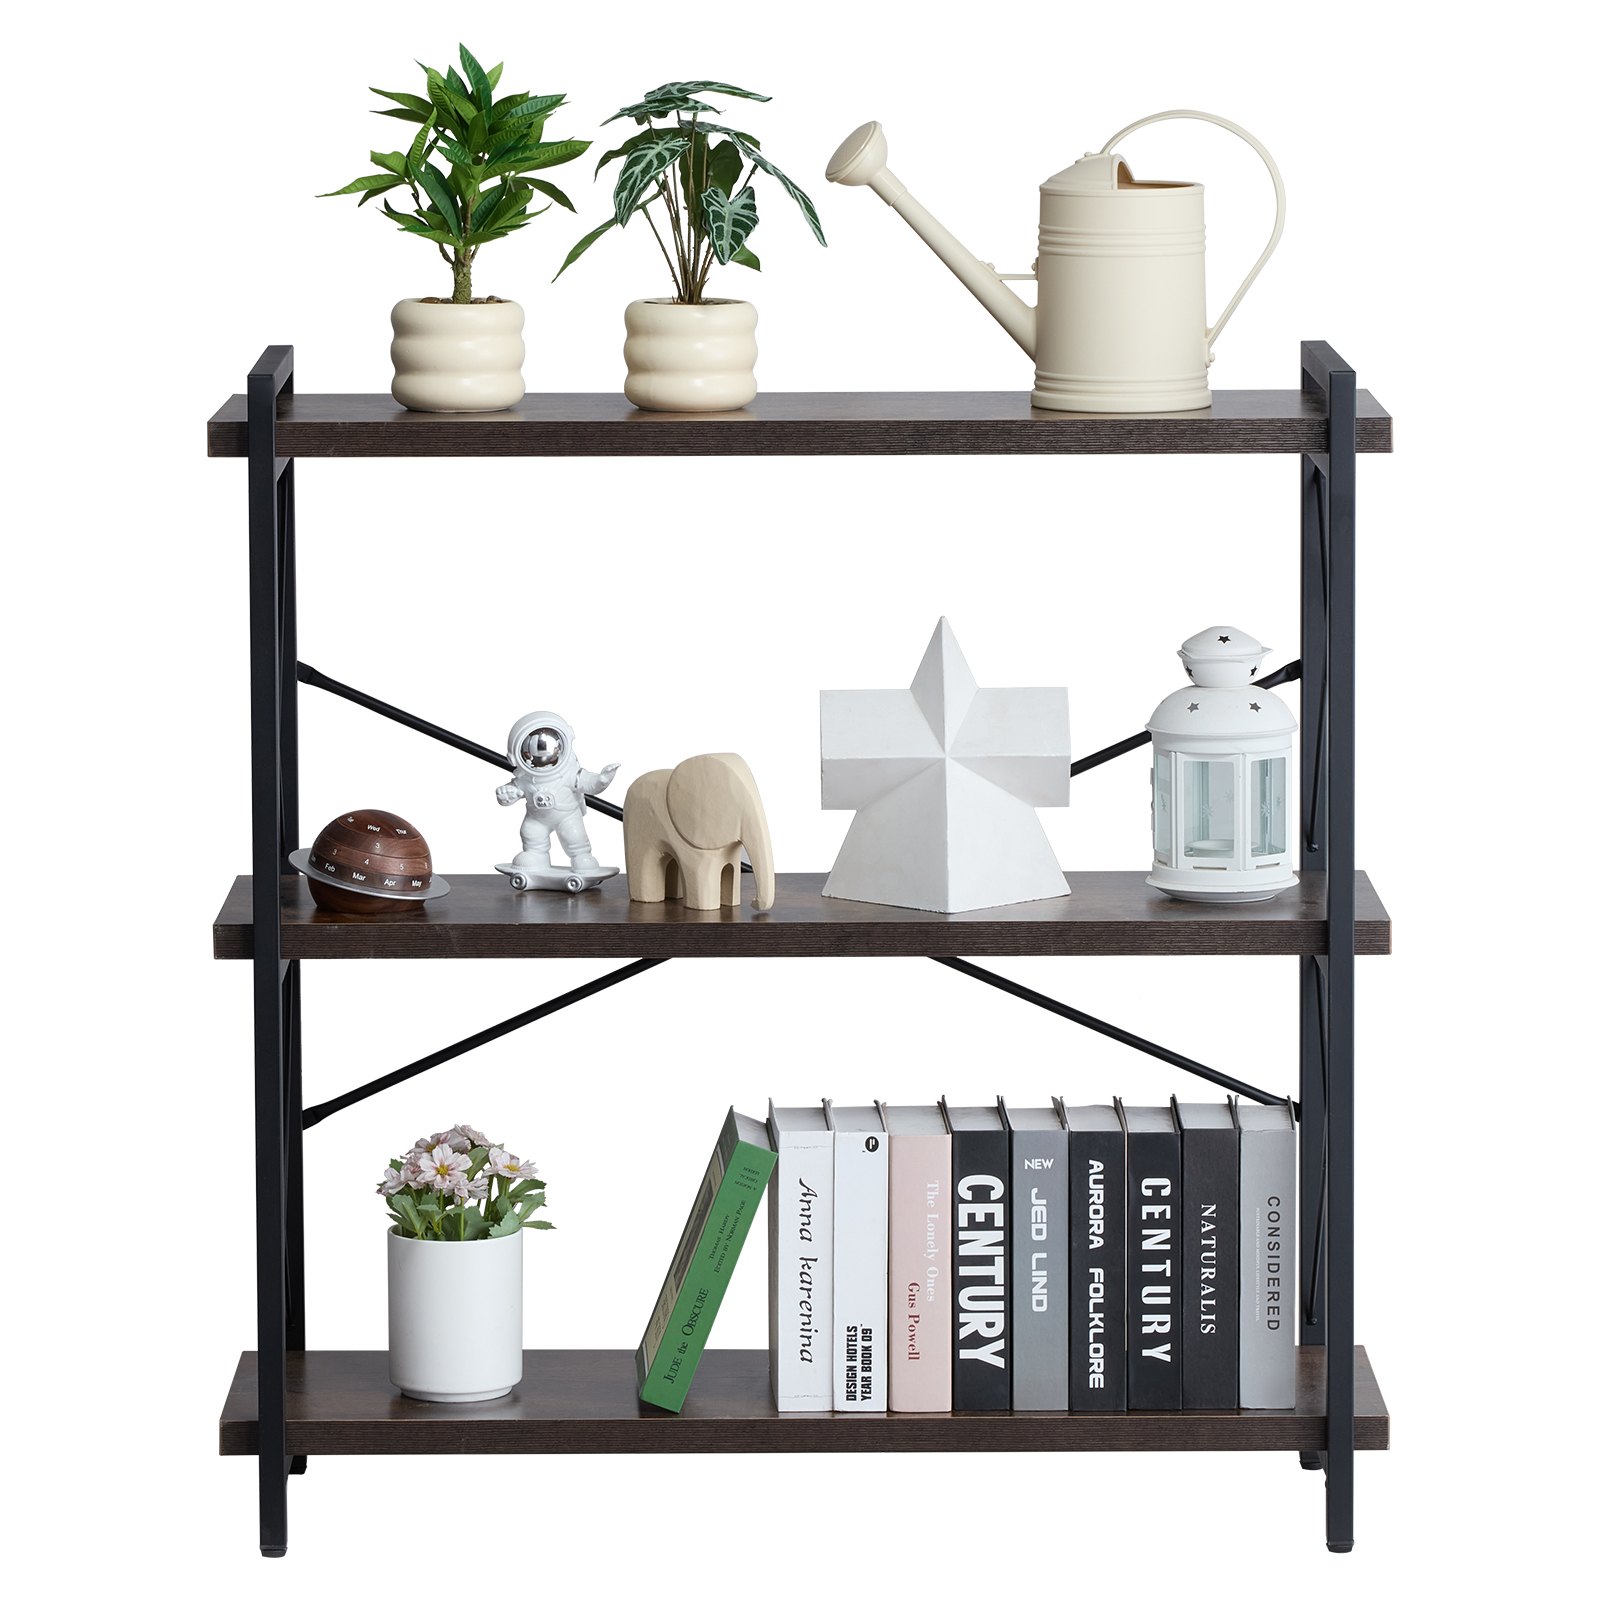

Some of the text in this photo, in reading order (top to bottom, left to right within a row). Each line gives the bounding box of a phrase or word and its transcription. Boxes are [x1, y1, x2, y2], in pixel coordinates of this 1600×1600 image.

[332, 848, 338, 856] 3
[367, 824, 381, 832] Wed
[325, 862, 336, 873] Feb
[352, 872, 366, 882] Mar
[383, 878, 396, 887] Apr
[411, 879, 423, 888] May
[1024, 1158, 1054, 1170] NEW
[708, 1236, 721, 1260] THOMAS
[726, 1216, 740, 1242] NORMAN
[924, 1179, 940, 1302] The Lonely Ones
[1031, 1188, 1047, 1312] JED LIND
[1267, 1196, 1281, 1331] CONSIDERED
[798, 1177, 818, 1364] Anna karenina
[957, 1174, 1005, 1369] CENTURY
[1088, 1160, 1104, 1389] AURORA FOLKLORE
[1141, 1177, 1172, 1362] CENTURY
[1200, 1204, 1216, 1334] NATURALIS
[677, 1341, 689, 1355] the
[681, 1287, 709, 1336] OBSCURE
[908, 1282, 921, 1361] Gus Powell
[663, 1357, 683, 1384] JUDE
[845, 1325, 857, 1401] DESIGN HOTELS
[861, 1328, 873, 1401] YEAR BOOK 09
